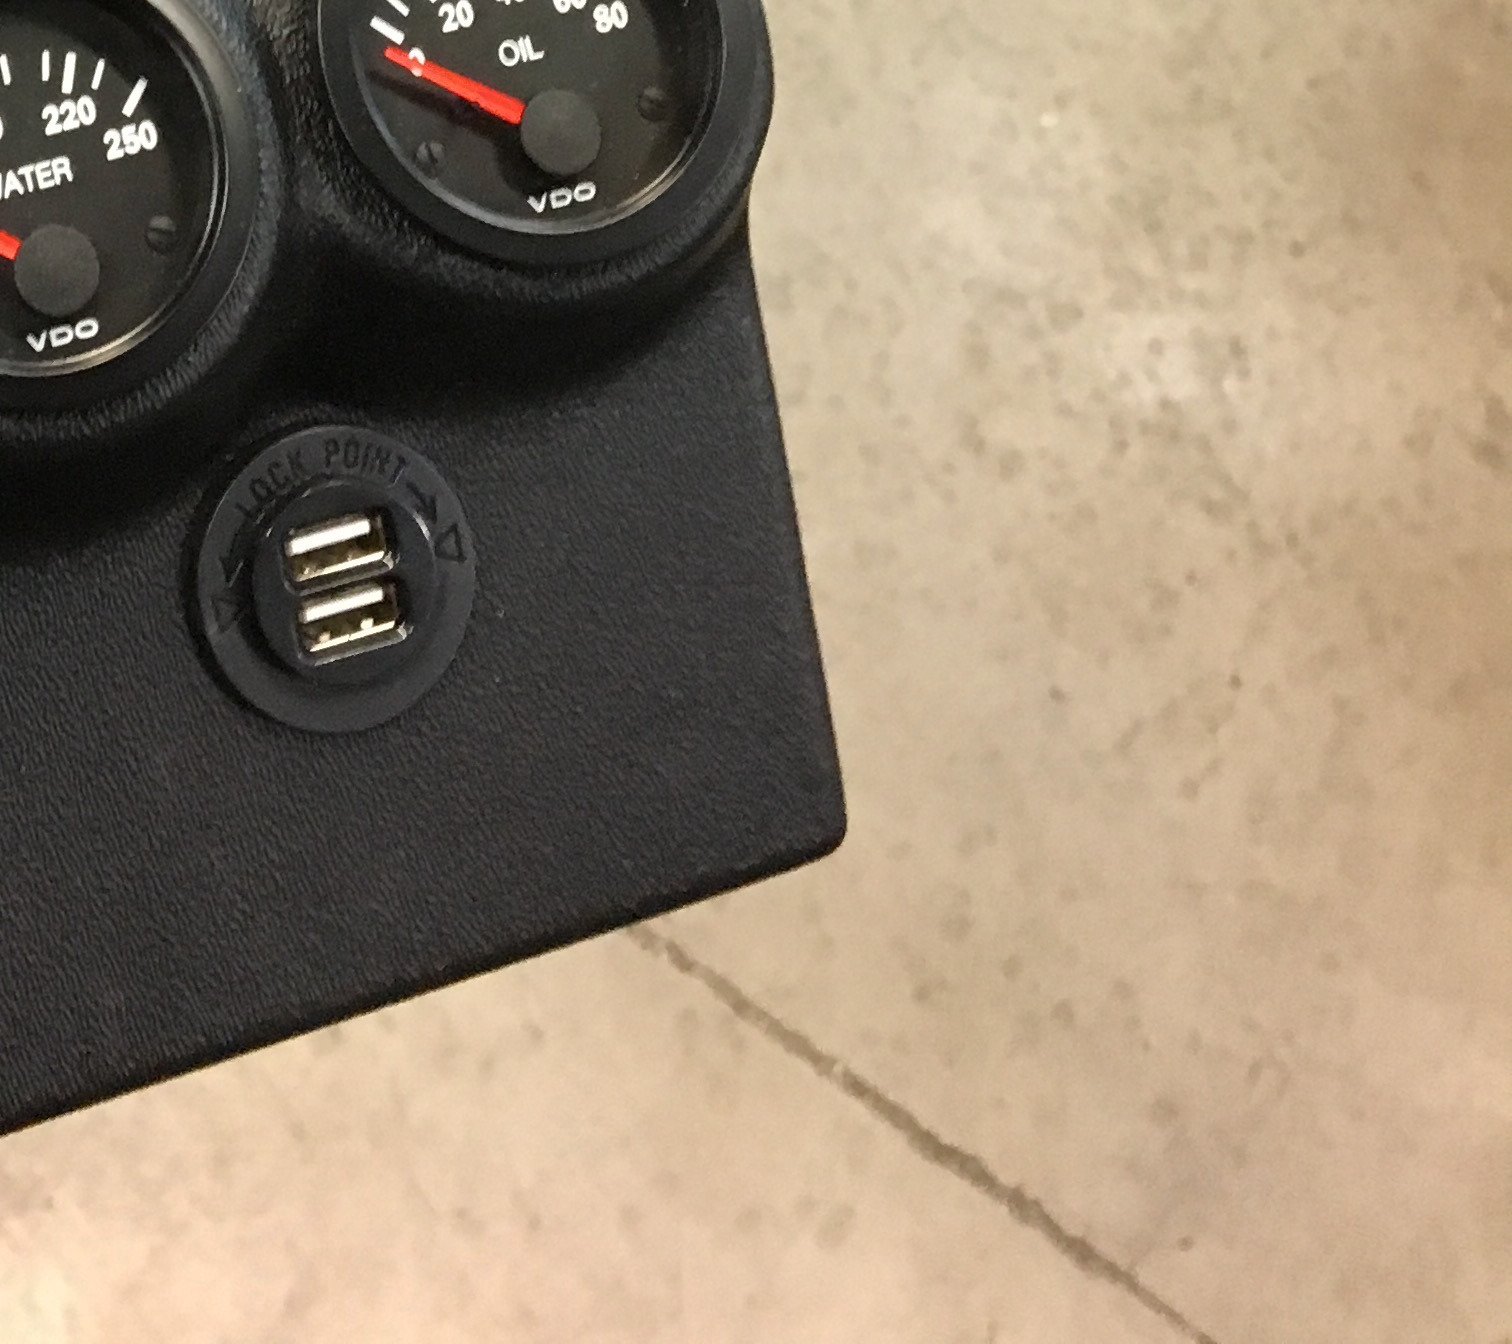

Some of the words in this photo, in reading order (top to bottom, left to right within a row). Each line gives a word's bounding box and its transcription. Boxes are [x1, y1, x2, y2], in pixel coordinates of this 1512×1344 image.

[592, 0, 629, 34] 80
[498, 35, 545, 67] OIL
[41, 94, 97, 136] 220
[103, 119, 158, 161] 250
[526, 182, 597, 213] VDO
[25, 318, 99, 353] VDO
[324, 436, 406, 485] POINT
